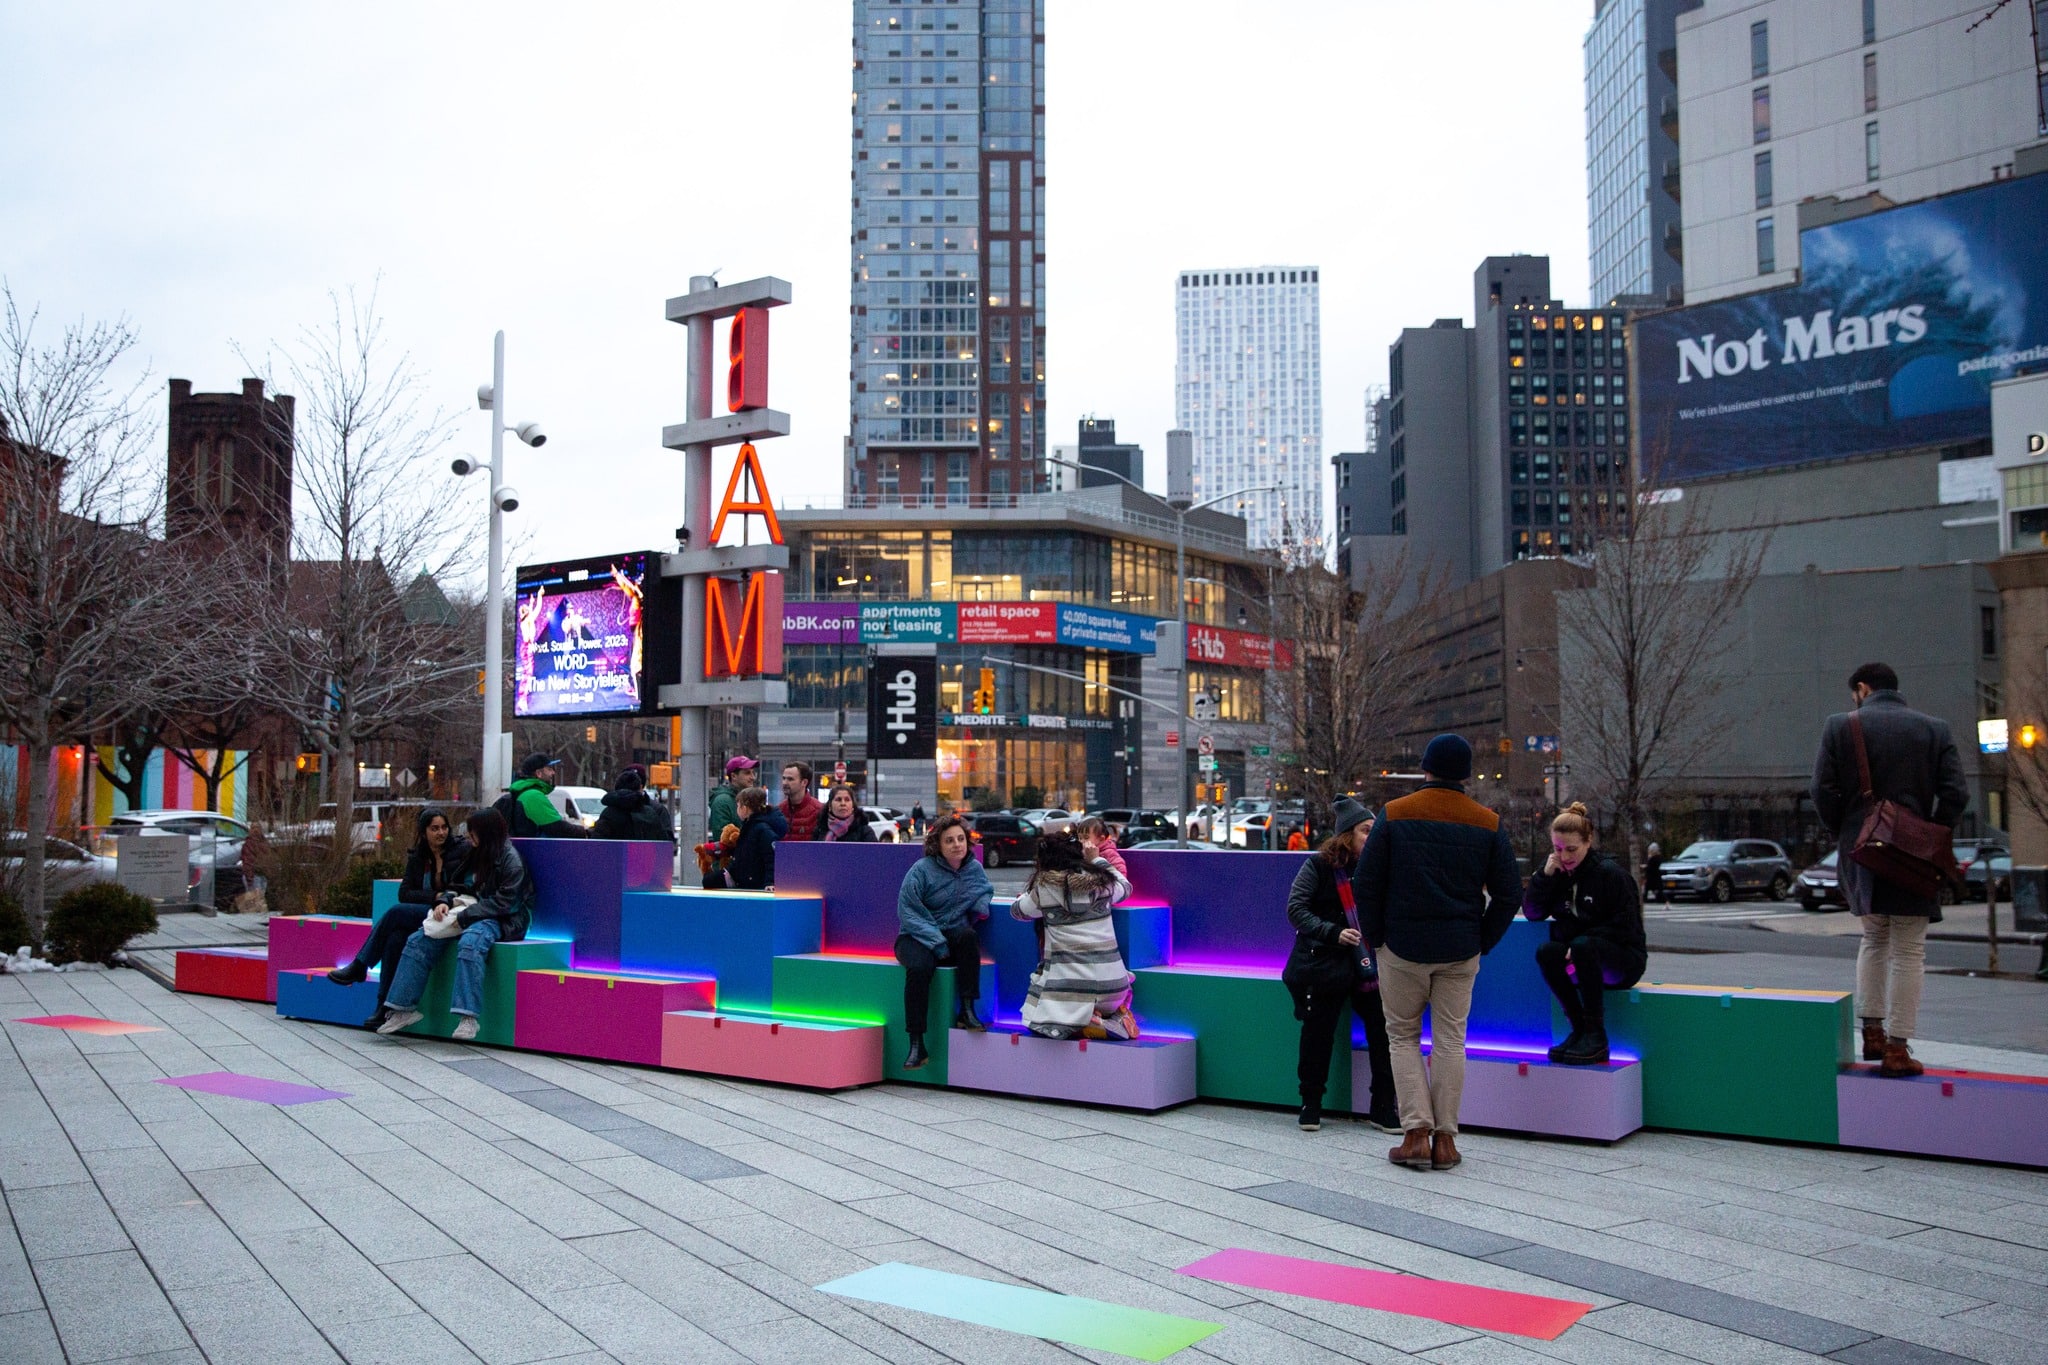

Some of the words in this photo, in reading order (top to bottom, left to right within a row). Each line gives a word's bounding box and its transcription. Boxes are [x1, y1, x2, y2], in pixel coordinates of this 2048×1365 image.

[1677, 327, 1770, 384] Not
[1781, 304, 1928, 365] Mars
[1679, 407, 1706, 420] We're
[1708, 403, 1718, 416] in
[1718, 398, 1761, 415] business
[1762, 396, 1772, 407] to
[1773, 393, 1795, 405] save
[1796, 390, 1815, 401] our
[1816, 384, 1846, 398] home
[863, 605, 941, 619] apartments
[961, 604, 997, 618] retail
[1000, 606, 1040, 620] space
[894, 619, 942, 635] leasing
[1088, 615, 1112, 629] square
[1062, 624, 1072, 636] of
[1072, 626, 1097, 640] private
[1098, 630, 1132, 645] amenities
[886, 669, 917, 731] Hub
[954, 715, 1006, 726] MEDRITE
[1028, 714, 1067, 729] MEDRITE
